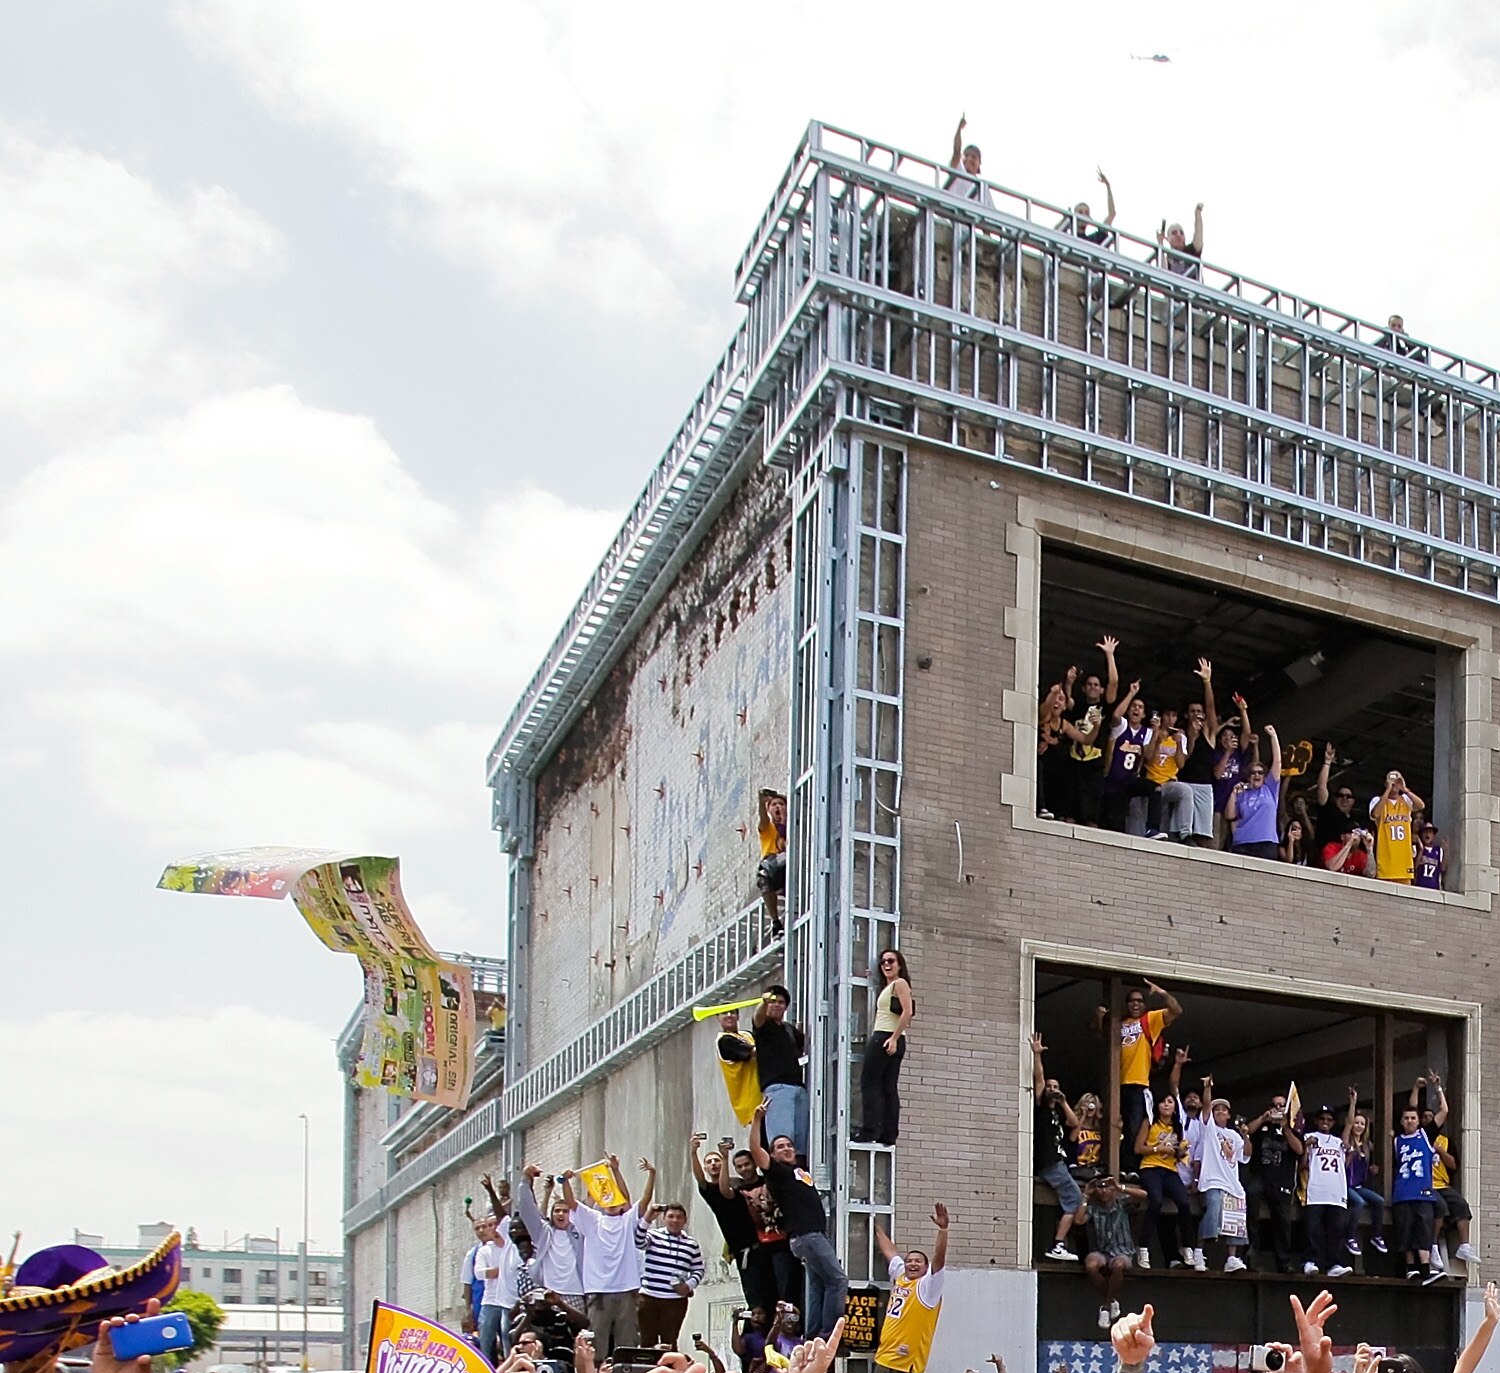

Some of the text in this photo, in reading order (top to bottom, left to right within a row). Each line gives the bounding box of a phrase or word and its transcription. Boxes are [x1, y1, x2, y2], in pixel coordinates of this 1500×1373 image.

[1123, 752, 1136, 770] 8
[1390, 825, 1405, 841] 16
[1423, 864, 1436, 878] 17
[1320, 1157, 1340, 1173] 24
[1400, 1160, 1424, 1179] 44
[400, 1328, 431, 1341] BACK
[843, 1330, 873, 1342] SHAQ
[395, 1339, 458, 1361] BACK NBA
